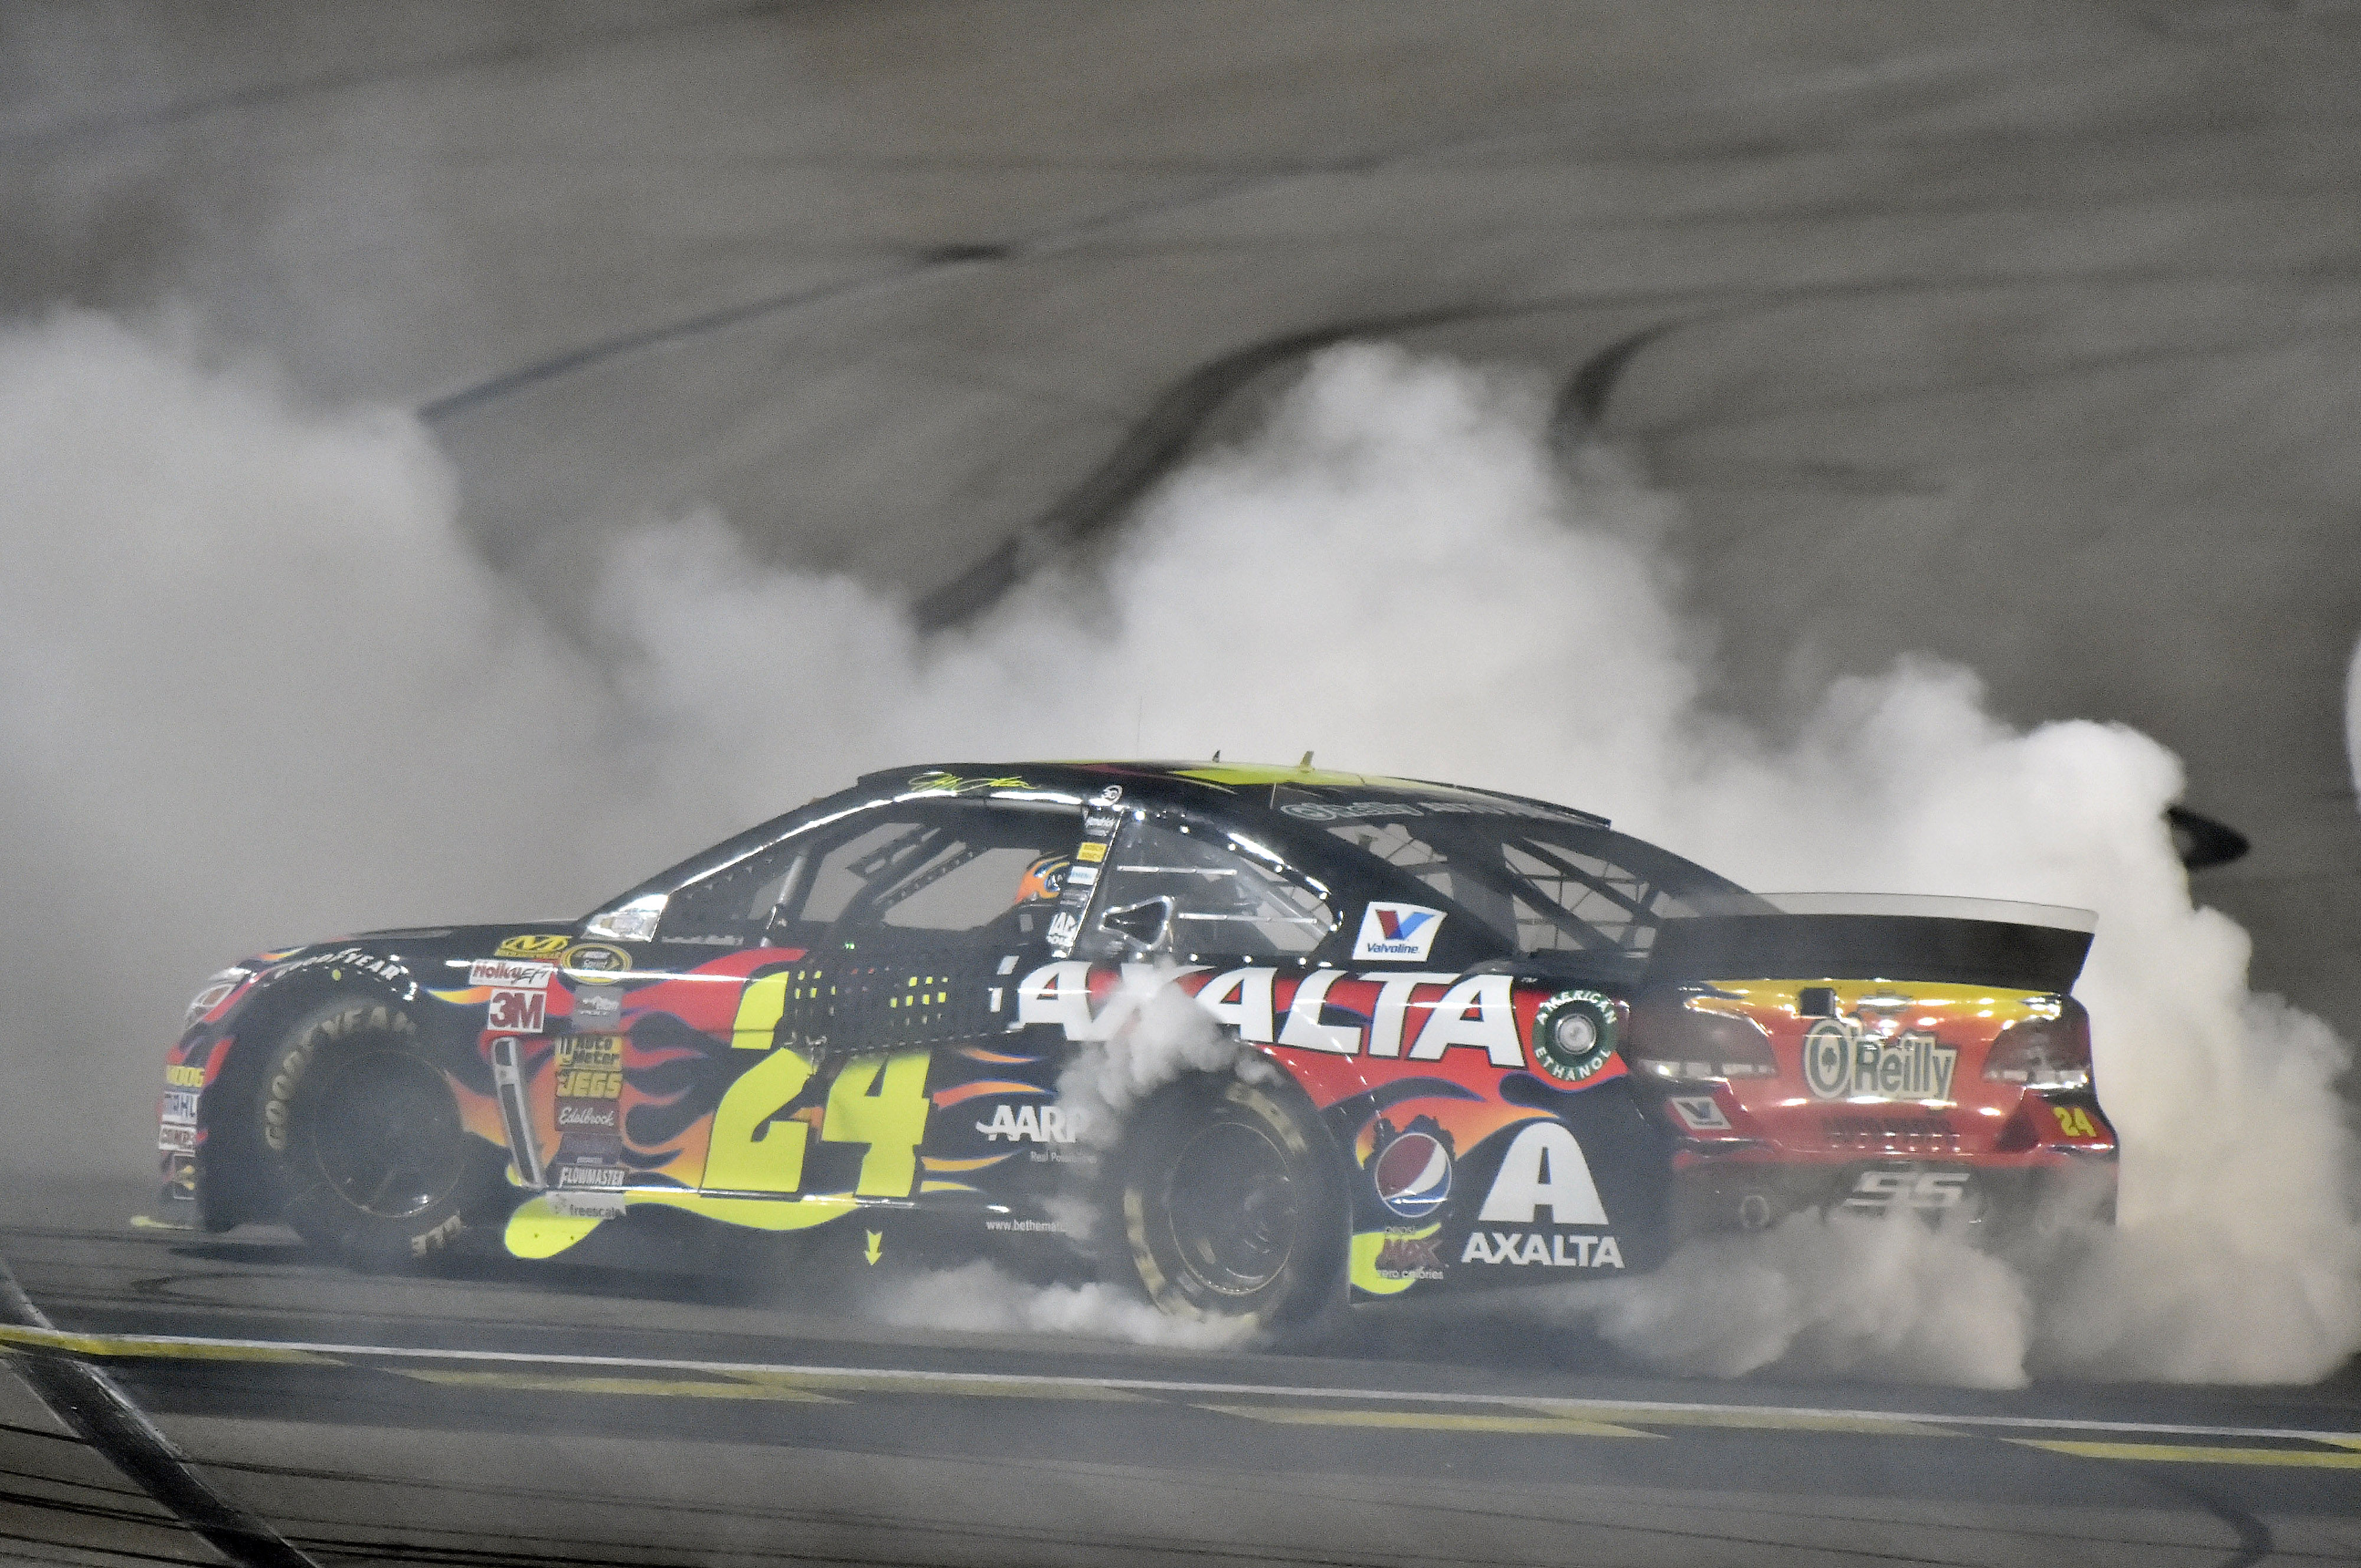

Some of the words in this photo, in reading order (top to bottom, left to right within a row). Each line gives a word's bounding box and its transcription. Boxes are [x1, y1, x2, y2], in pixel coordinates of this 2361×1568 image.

[1367, 942, 1419, 954] Valvoline
[490, 991, 545, 1029] 3M
[1536, 989, 1618, 1026] AMERICAN
[1535, 1046, 1612, 1081] ETHANOL
[1804, 1019, 1957, 1110] O'Reilly
[557, 1072, 623, 1098] JEGS
[701, 970, 931, 1199] 24
[560, 1107, 614, 1127] Edelbrock
[976, 1104, 1090, 1143] AARP
[2053, 1106, 2097, 1137] 24
[558, 1166, 625, 1189] FLOWMASTER
[1461, 1231, 1625, 1269] AXALTA
